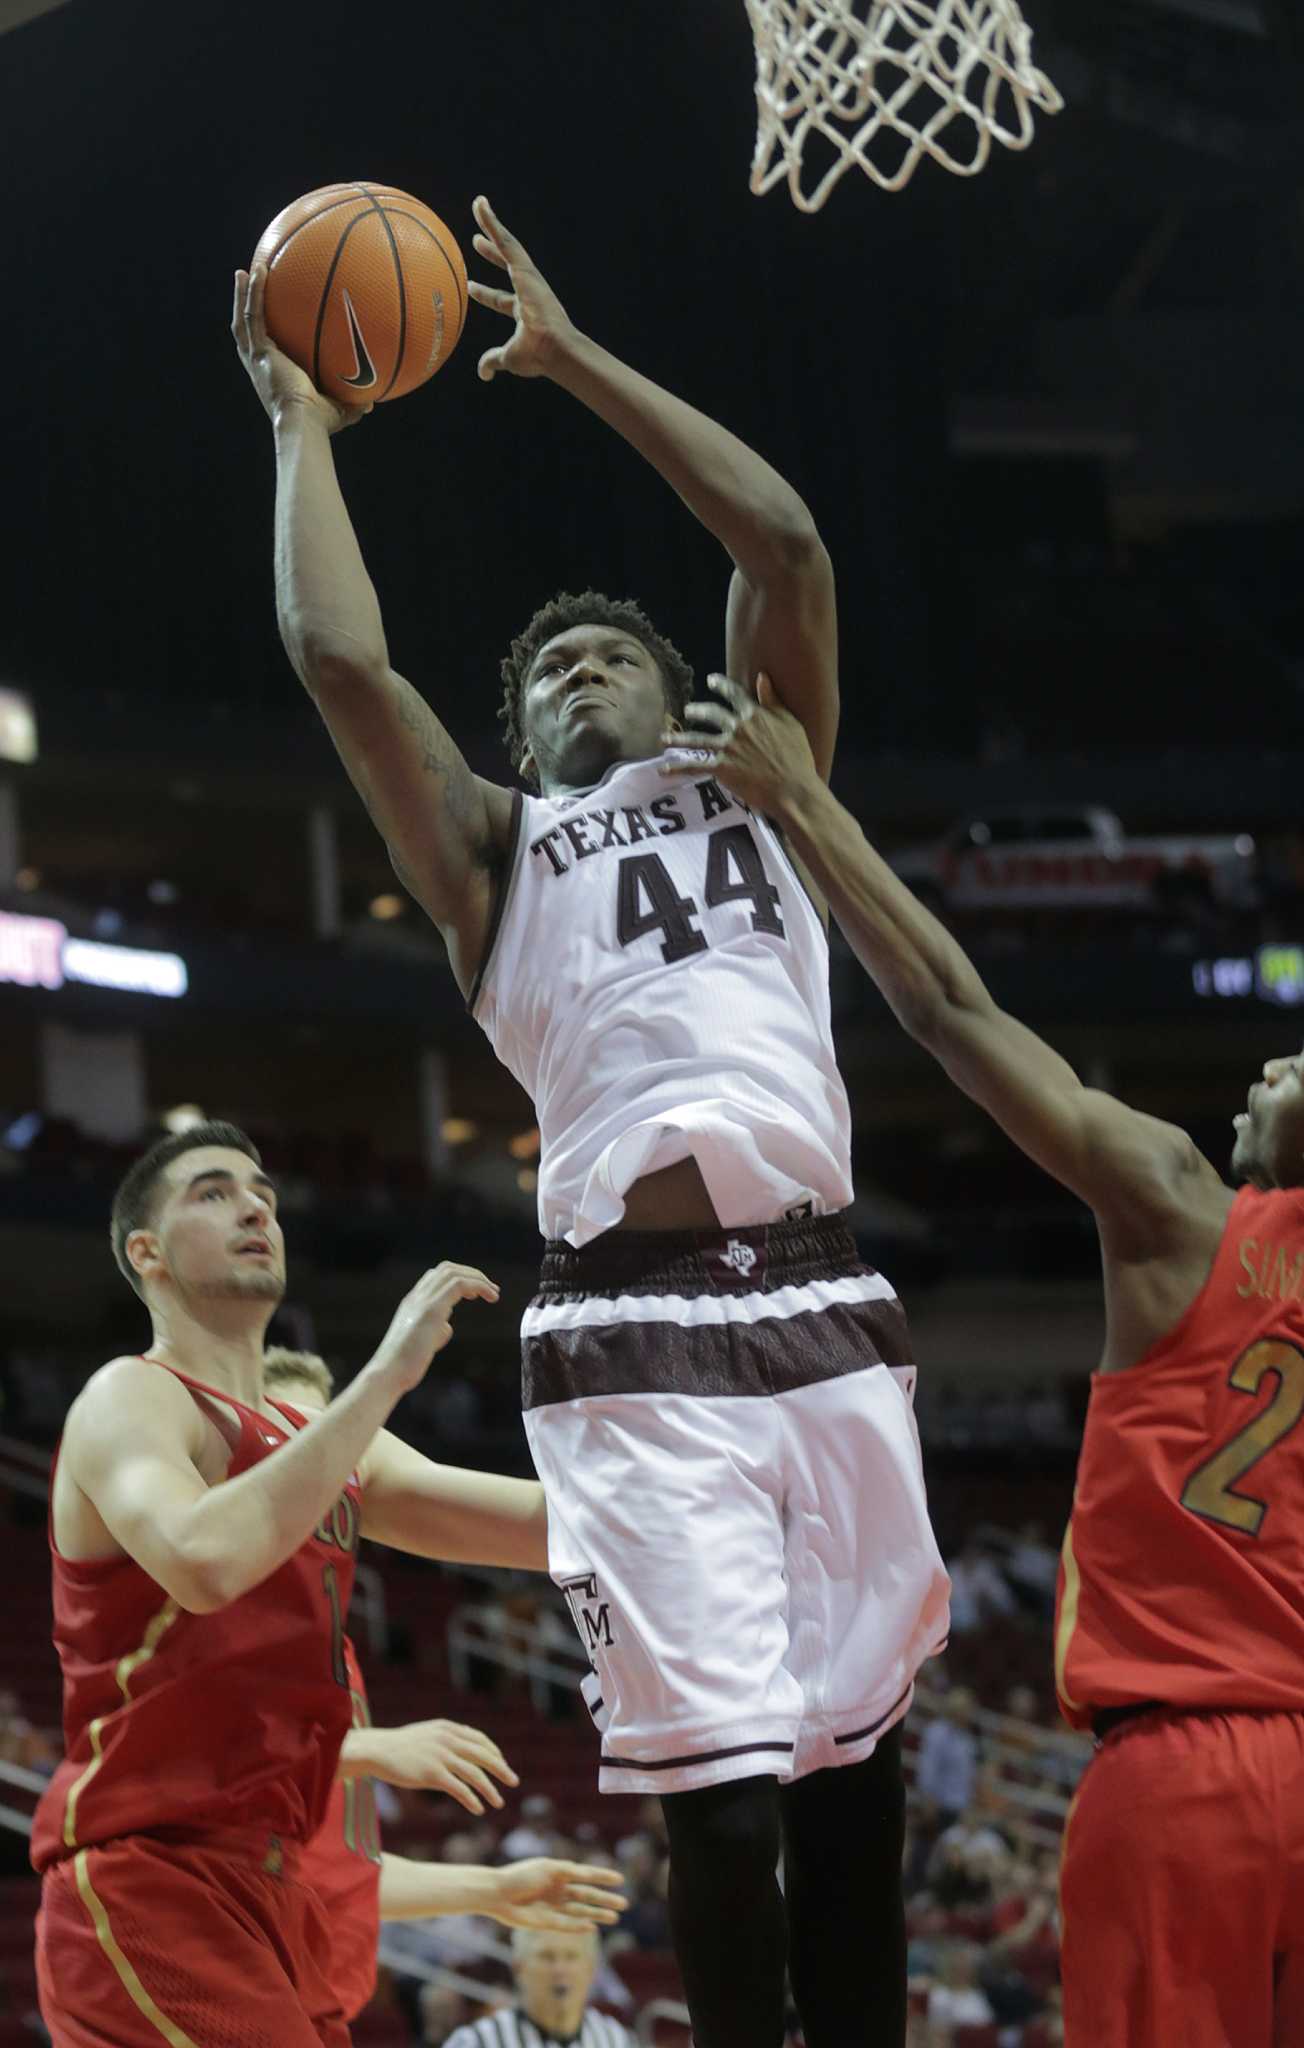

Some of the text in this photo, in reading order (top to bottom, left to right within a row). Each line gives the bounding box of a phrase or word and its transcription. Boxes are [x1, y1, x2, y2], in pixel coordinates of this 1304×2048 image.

[530, 794, 687, 877] TEXAS
[616, 823, 786, 965] 44
[1180, 1336, 1304, 1537] 2
